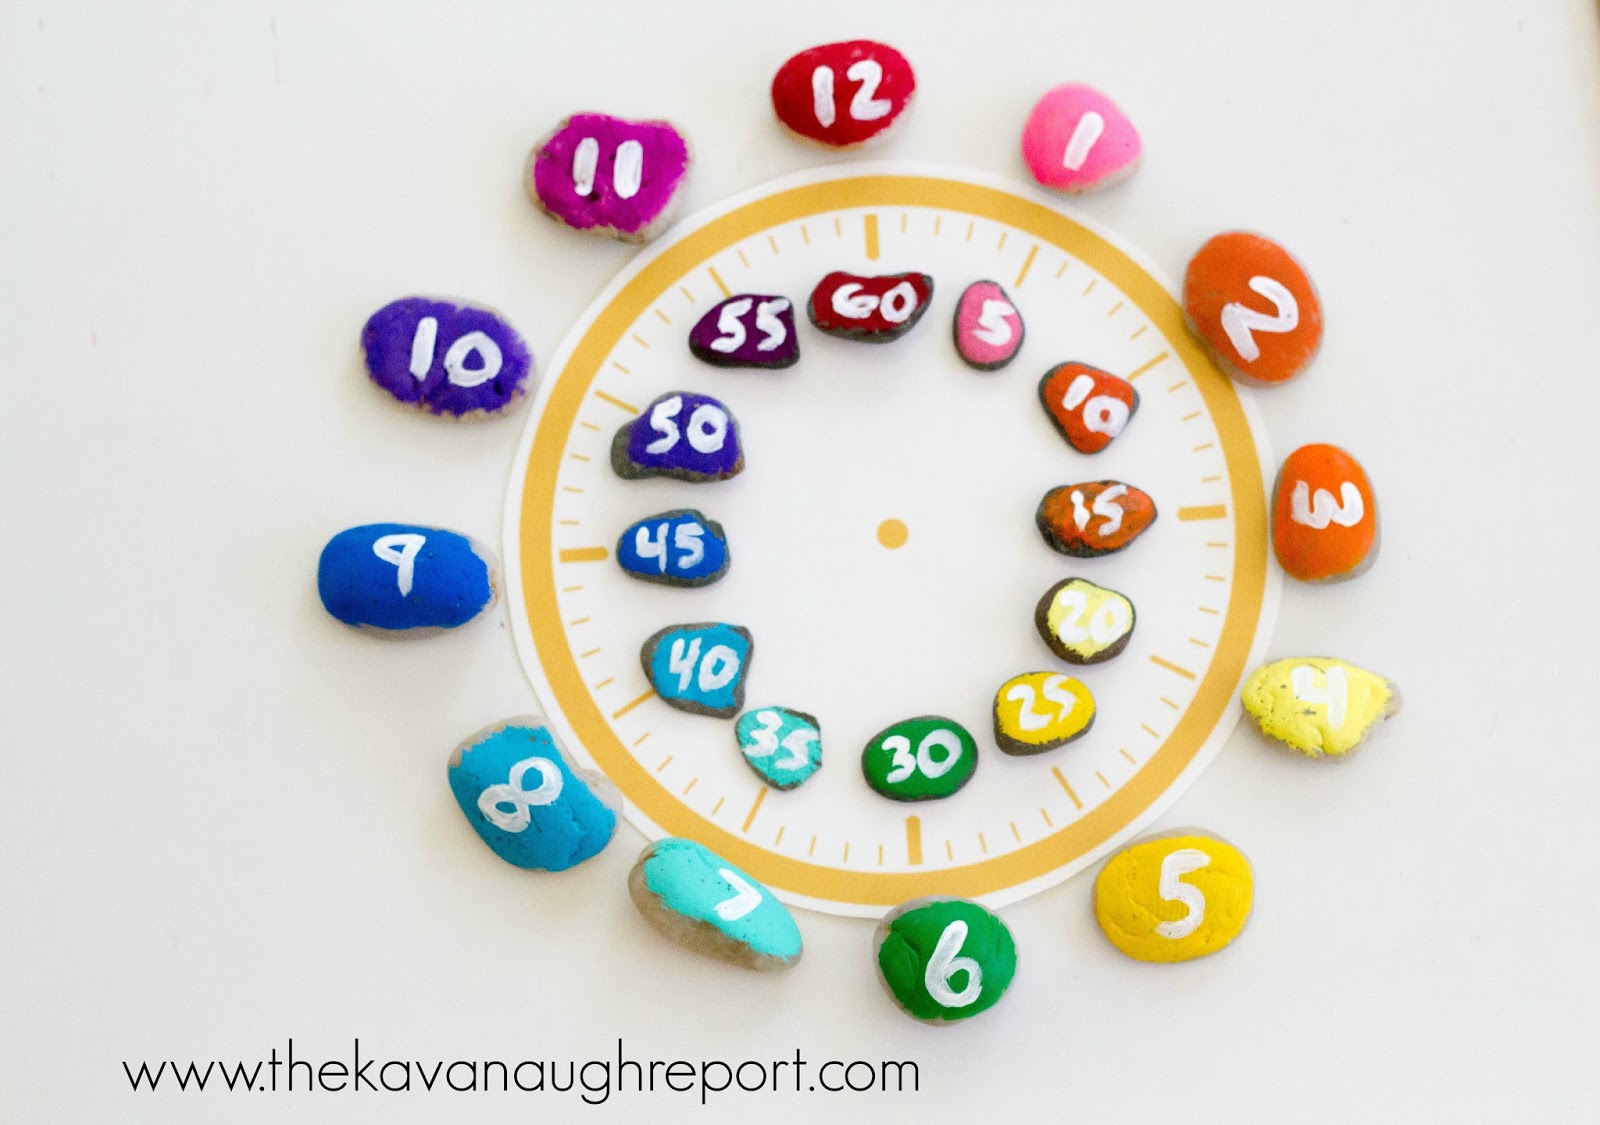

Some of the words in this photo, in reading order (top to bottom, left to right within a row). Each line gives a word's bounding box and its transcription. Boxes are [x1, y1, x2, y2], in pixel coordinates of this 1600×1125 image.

[812, 59, 891, 127] 12
[573, 137, 643, 199] 11
[1064, 111, 1105, 170] 1
[710, 297, 790, 353] 55
[832, 282, 917, 323] 60
[973, 299, 1015, 346] 5
[1221, 275, 1299, 362] 2
[410, 316, 502, 388] 10
[644, 395, 728, 455] 50
[1063, 374, 1130, 438] 10
[1070, 484, 1128, 535] 15
[1292, 480, 1363, 529] 3
[373, 534, 425, 596] 9
[636, 522, 704, 573] 45
[1058, 589, 1126, 642] 20
[670, 637, 739, 692] 40
[1006, 674, 1076, 730] 25
[1293, 665, 1347, 727] 4
[744, 710, 820, 771] 35
[881, 728, 963, 784] 30
[478, 756, 563, 832] 8
[714, 867, 763, 921] 7
[1157, 850, 1212, 938] 5
[925, 919, 982, 1007] 6
